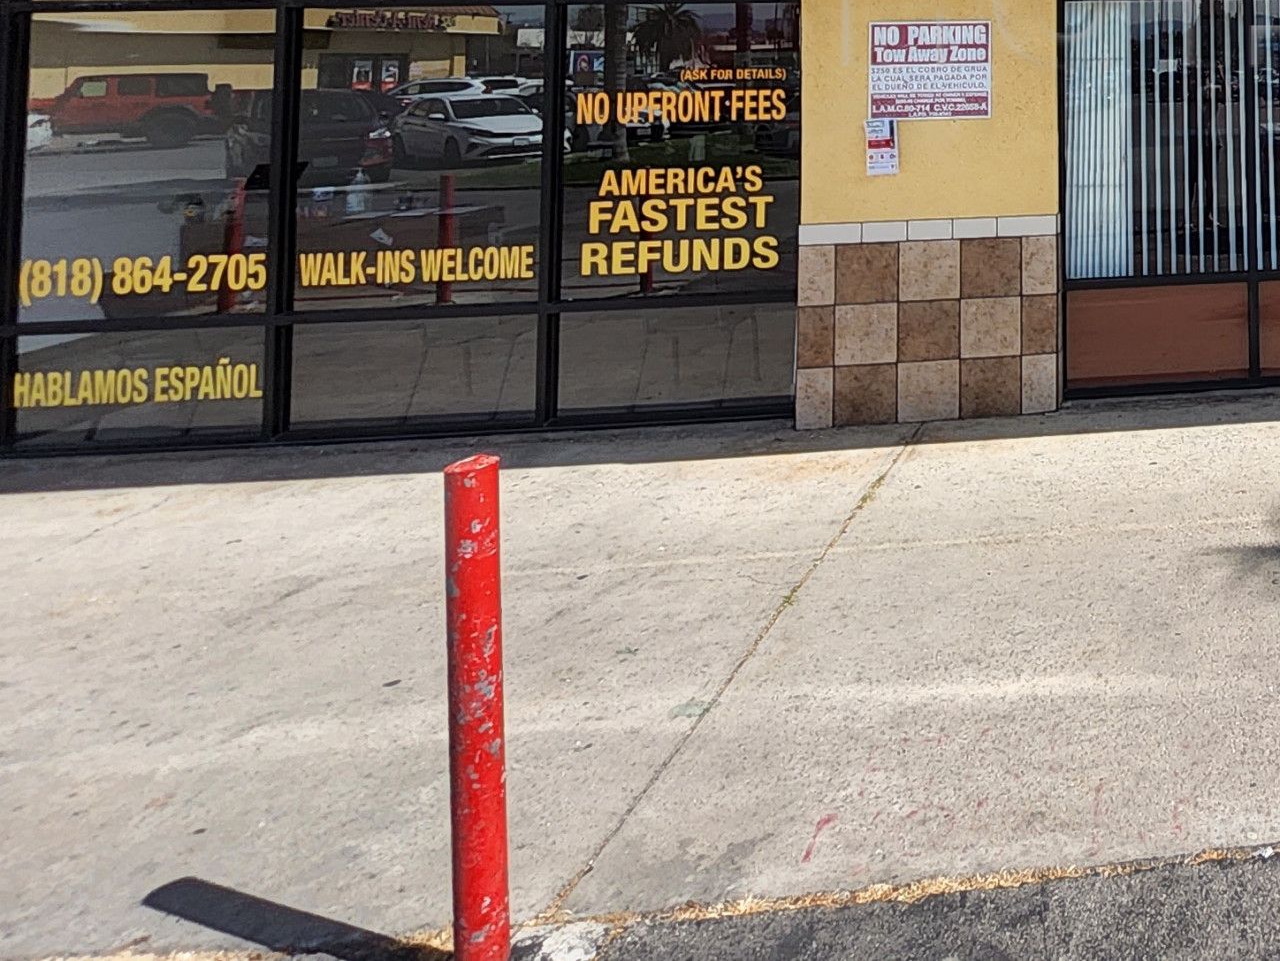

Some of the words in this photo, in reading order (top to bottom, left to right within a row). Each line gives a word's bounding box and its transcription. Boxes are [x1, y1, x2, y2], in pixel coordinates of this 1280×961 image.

[874, 26, 900, 46] NO
[907, 25, 987, 46] PARKING
[874, 47, 906, 62] Tow
[907, 46, 948, 63] Away
[949, 45, 987, 62] Zone
[918, 66, 948, 74] COBRO
[680, 69, 709, 82] (ASK
[711, 69, 733, 80] FOR
[736, 68, 787, 81] DETAILS)
[577, 92, 610, 125] NO
[616, 90, 725, 125] UPFRONT
[731, 89, 787, 122] FEES
[599, 166, 763, 196] AMERICA'S
[588, 196, 774, 234] FASTEST
[300, 249, 415, 286] WALK-INS
[421, 245, 534, 282] WELCOME
[581, 236, 779, 276] REFUNDS
[19, 258, 103, 306] (818)
[112, 253, 267, 295] 864-2705
[13, 367, 149, 408] HABLAMOS
[154, 357, 263, 403] ESPAÑOL
